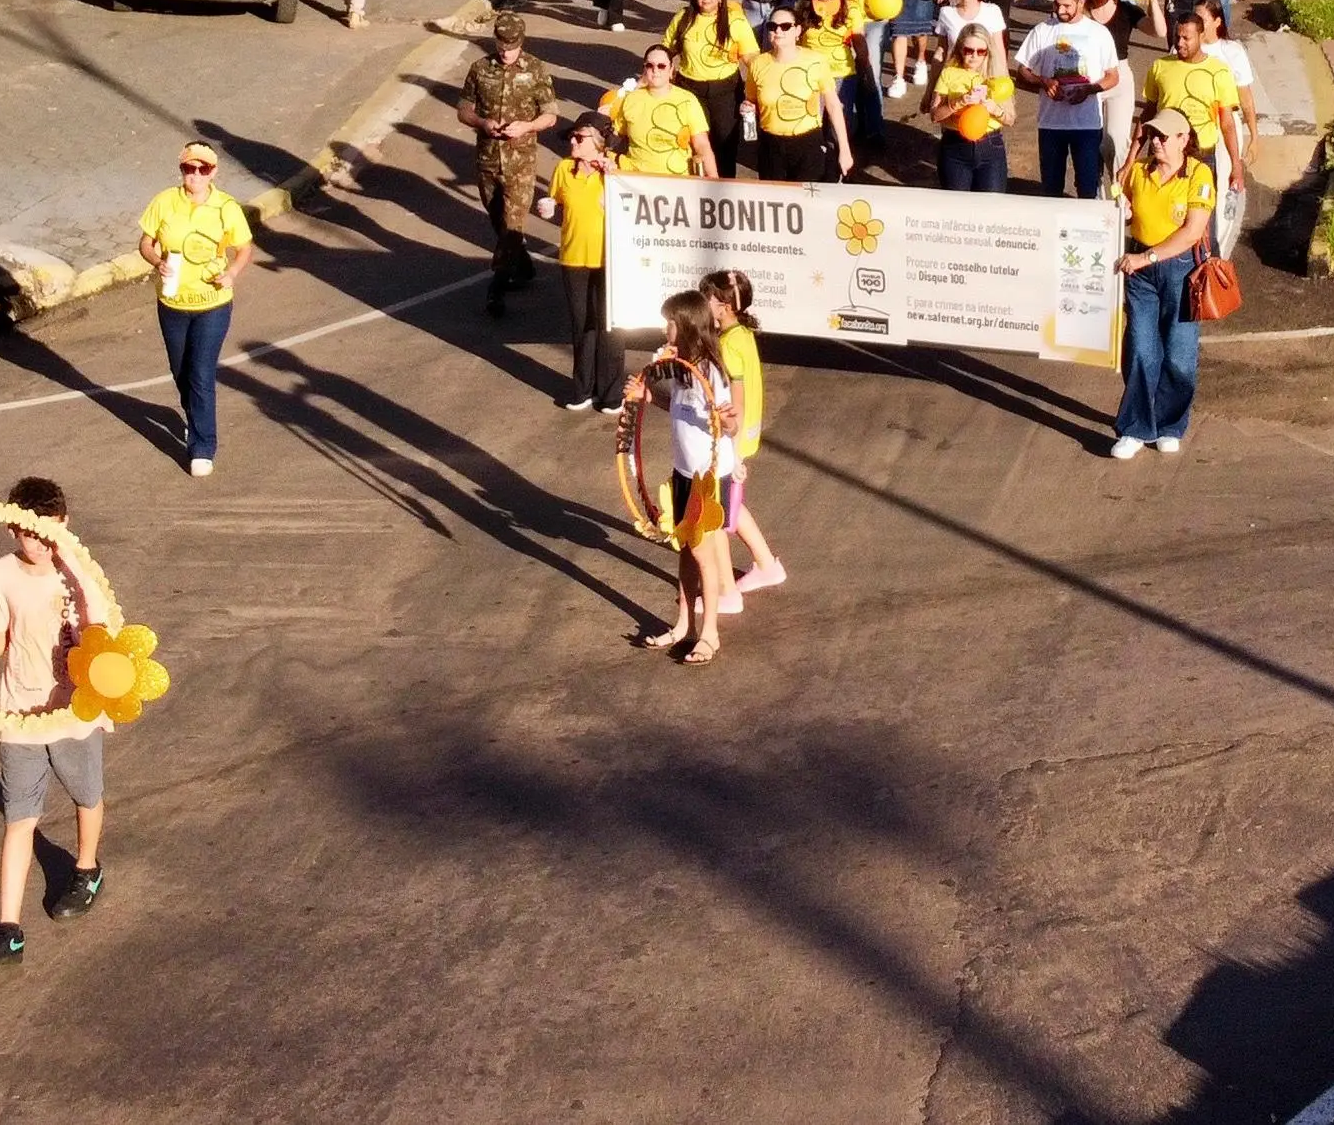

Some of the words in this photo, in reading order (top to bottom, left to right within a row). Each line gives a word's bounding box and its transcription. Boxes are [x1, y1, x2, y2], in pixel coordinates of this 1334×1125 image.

[699, 197, 804, 235] BONITO
[905, 216, 919, 228] Por
[921, 220, 940, 229] uma
[942, 219, 976, 233] infância
[985, 223, 1041, 237] adolescência
[653, 238, 687, 249] nossas
[689, 239, 730, 253] crianças
[732, 243, 738, 251] e
[740, 242, 807, 257] adolescentes.
[995, 238, 1040, 251] denuncie.
[661, 262, 676, 274] Dia
[678, 263, 717, 276] Nacional
[774, 271, 785, 281] ao
[906, 256, 939, 270] Procure
[947, 261, 988, 274] conselho
[990, 264, 1020, 277] tutelar
[661, 277, 689, 288] Abuso
[757, 284, 787, 295] Sexual
[860, 278, 881, 287] 100
[918, 271, 948, 285] Disque
